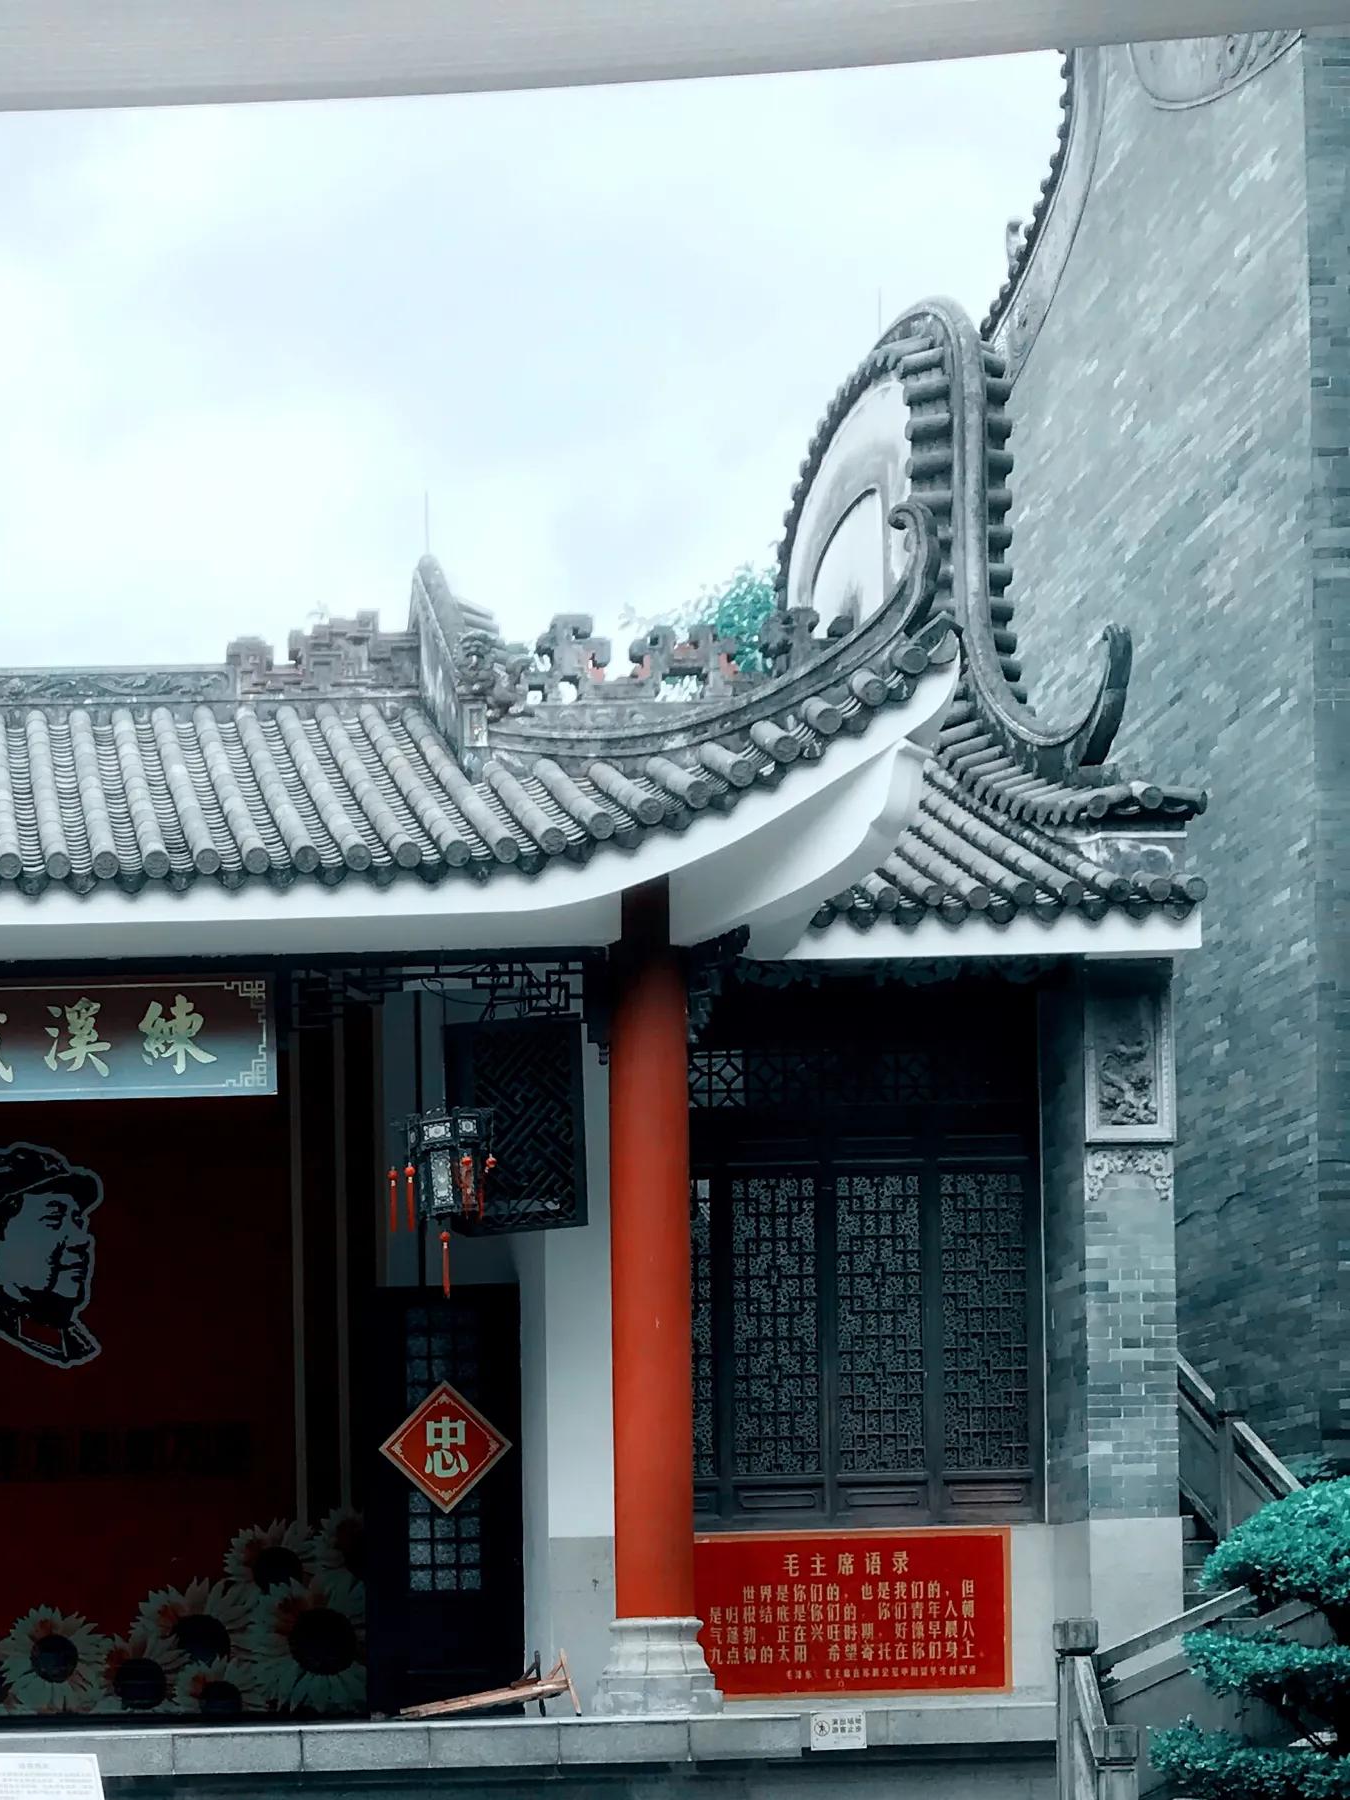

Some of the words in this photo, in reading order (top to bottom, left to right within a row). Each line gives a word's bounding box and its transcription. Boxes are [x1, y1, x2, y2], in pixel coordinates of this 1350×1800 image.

[424, 1416, 469, 1478] 忠
[782, 1551, 909, 1577] 毛主席语录
